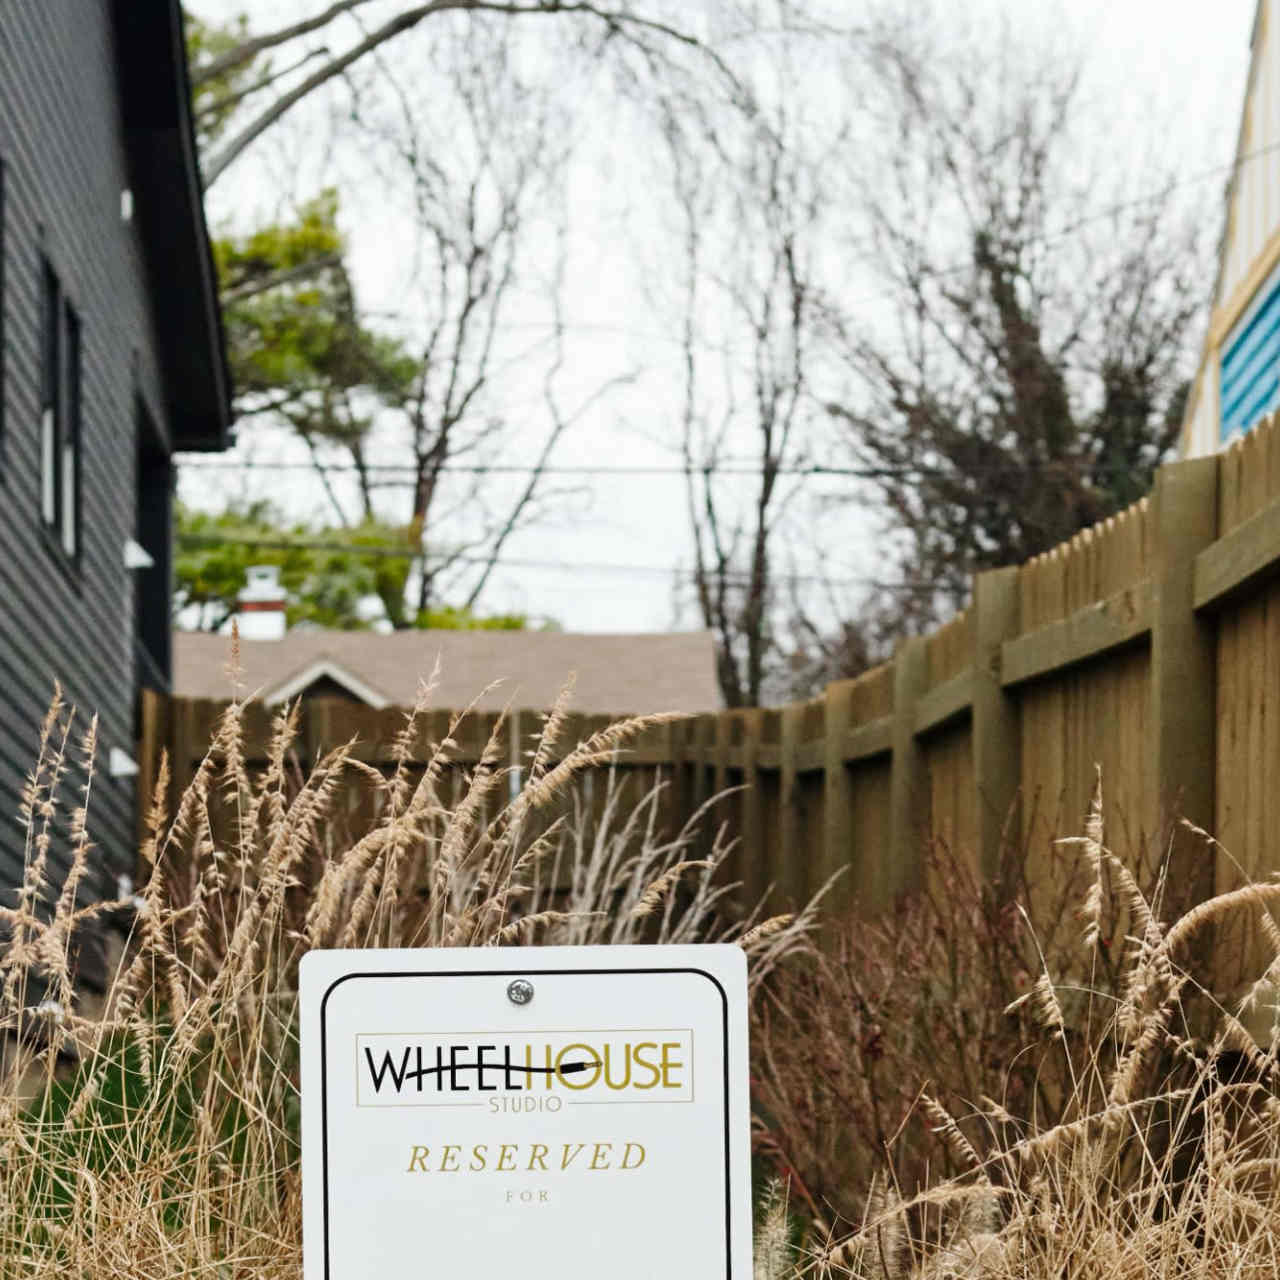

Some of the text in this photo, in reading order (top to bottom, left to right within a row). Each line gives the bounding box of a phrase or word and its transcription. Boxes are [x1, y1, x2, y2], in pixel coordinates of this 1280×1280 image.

[364, 1042, 683, 1093] WHEELHOUSE
[489, 1095, 562, 1114] STUDIO
[405, 1142, 647, 1173] RESERVED
[505, 1190, 551, 1203] FOR
